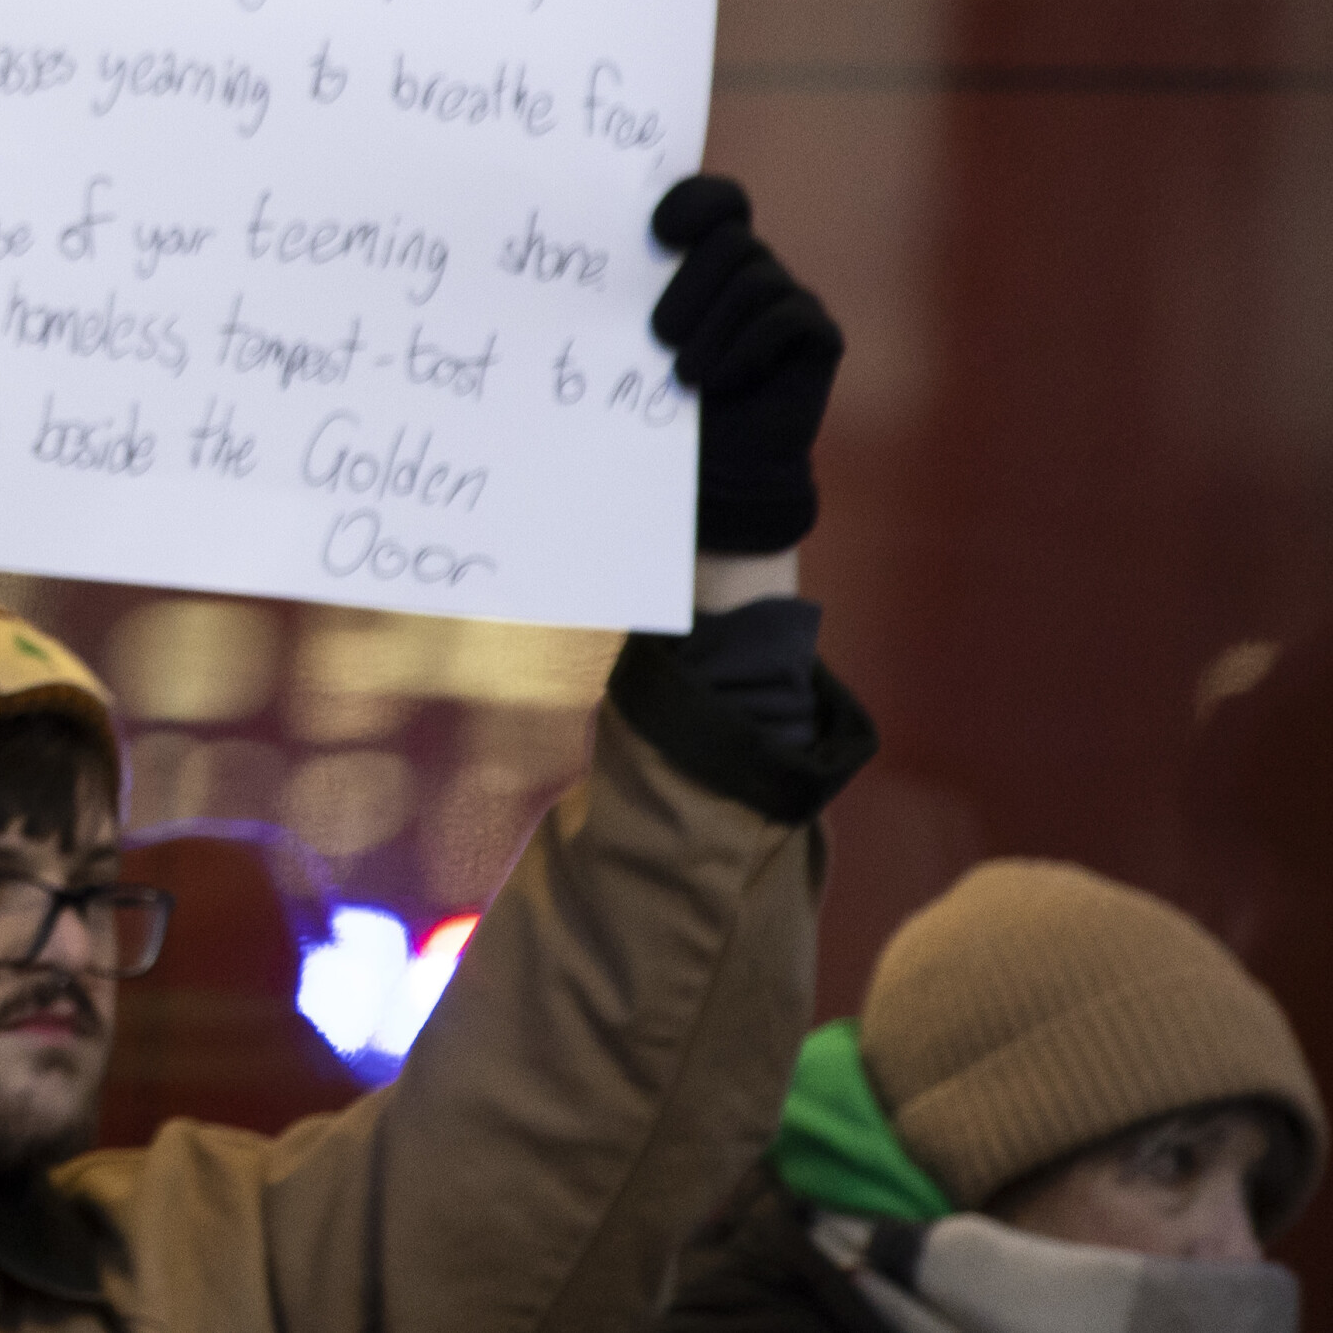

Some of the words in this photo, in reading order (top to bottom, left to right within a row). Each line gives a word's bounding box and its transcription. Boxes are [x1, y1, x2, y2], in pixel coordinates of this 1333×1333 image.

[89, 45, 271, 140] yearning
[306, 37, 349, 104] to
[389, 51, 557, 137] breathe
[581, 55, 665, 170] free,
[56, 173, 117, 261] of
[131, 220, 217, 281] your
[245, 188, 450, 307] teeming
[0, 277, 191, 379] homeless,
[551, 335, 589, 407] to
[31, 389, 157, 479] beside
[188, 393, 259, 480] the
[299, 405, 490, 514] Golden
